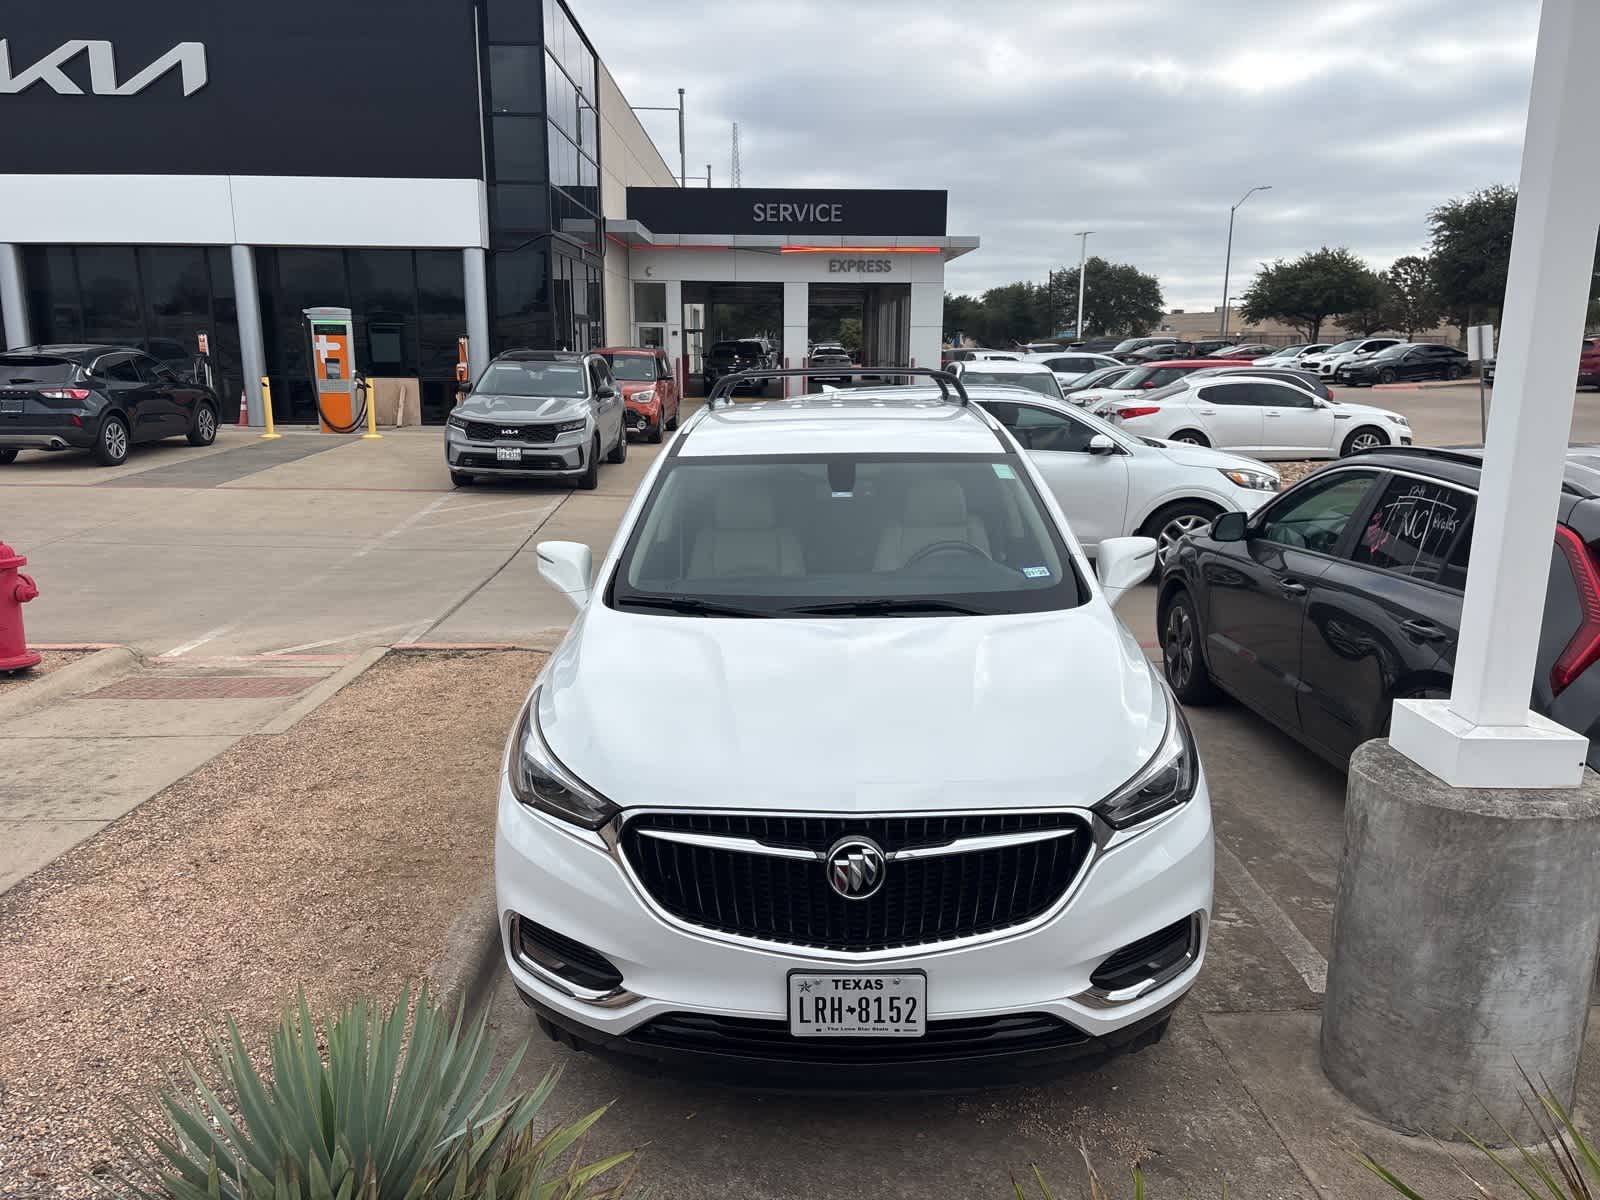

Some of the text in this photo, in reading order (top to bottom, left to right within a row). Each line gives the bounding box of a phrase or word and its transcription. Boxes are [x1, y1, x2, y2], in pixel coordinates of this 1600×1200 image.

[752, 203, 843, 223] SERVICE
[828, 259, 892, 273] EXPRESS
[832, 979, 884, 990] TEXAS
